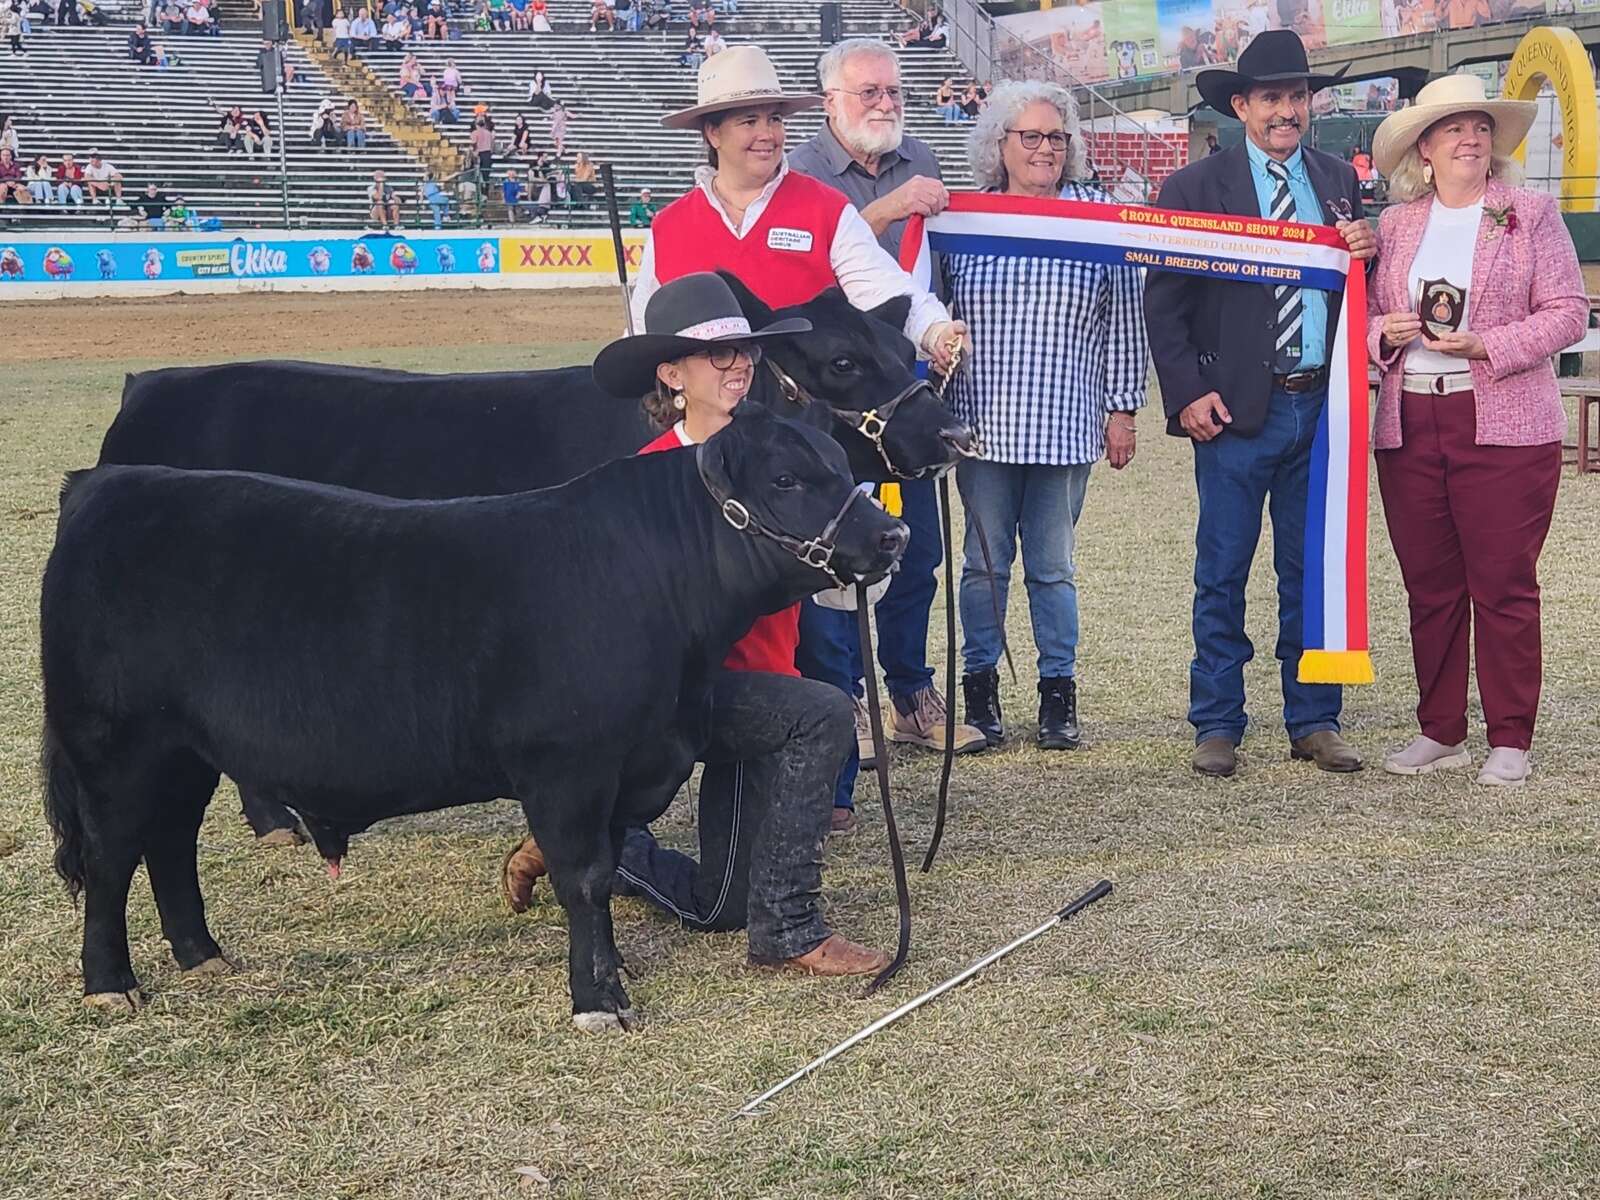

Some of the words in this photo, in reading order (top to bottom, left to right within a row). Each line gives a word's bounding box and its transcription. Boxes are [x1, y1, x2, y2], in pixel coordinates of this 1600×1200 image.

[1516, 41, 1569, 92] QUEENSLAND
[1566, 95, 1576, 168] SHOW
[1128, 210, 1167, 225] ROYAL
[1170, 215, 1244, 233] QUEENSLAND
[1246, 223, 1280, 236] SHOW
[1282, 226, 1305, 240] 2024
[231, 243, 288, 276] Ekka
[520, 245, 592, 266] XXXX
[1148, 233, 1219, 250] INTERBREED
[1221, 240, 1280, 257] CHAMPION
[1124, 251, 1163, 265] SMALL
[1164, 255, 1209, 271] BREEDS
[1211, 261, 1240, 274] COW
[1241, 264, 1259, 276] OR
[1261, 266, 1302, 281] HEIFER
